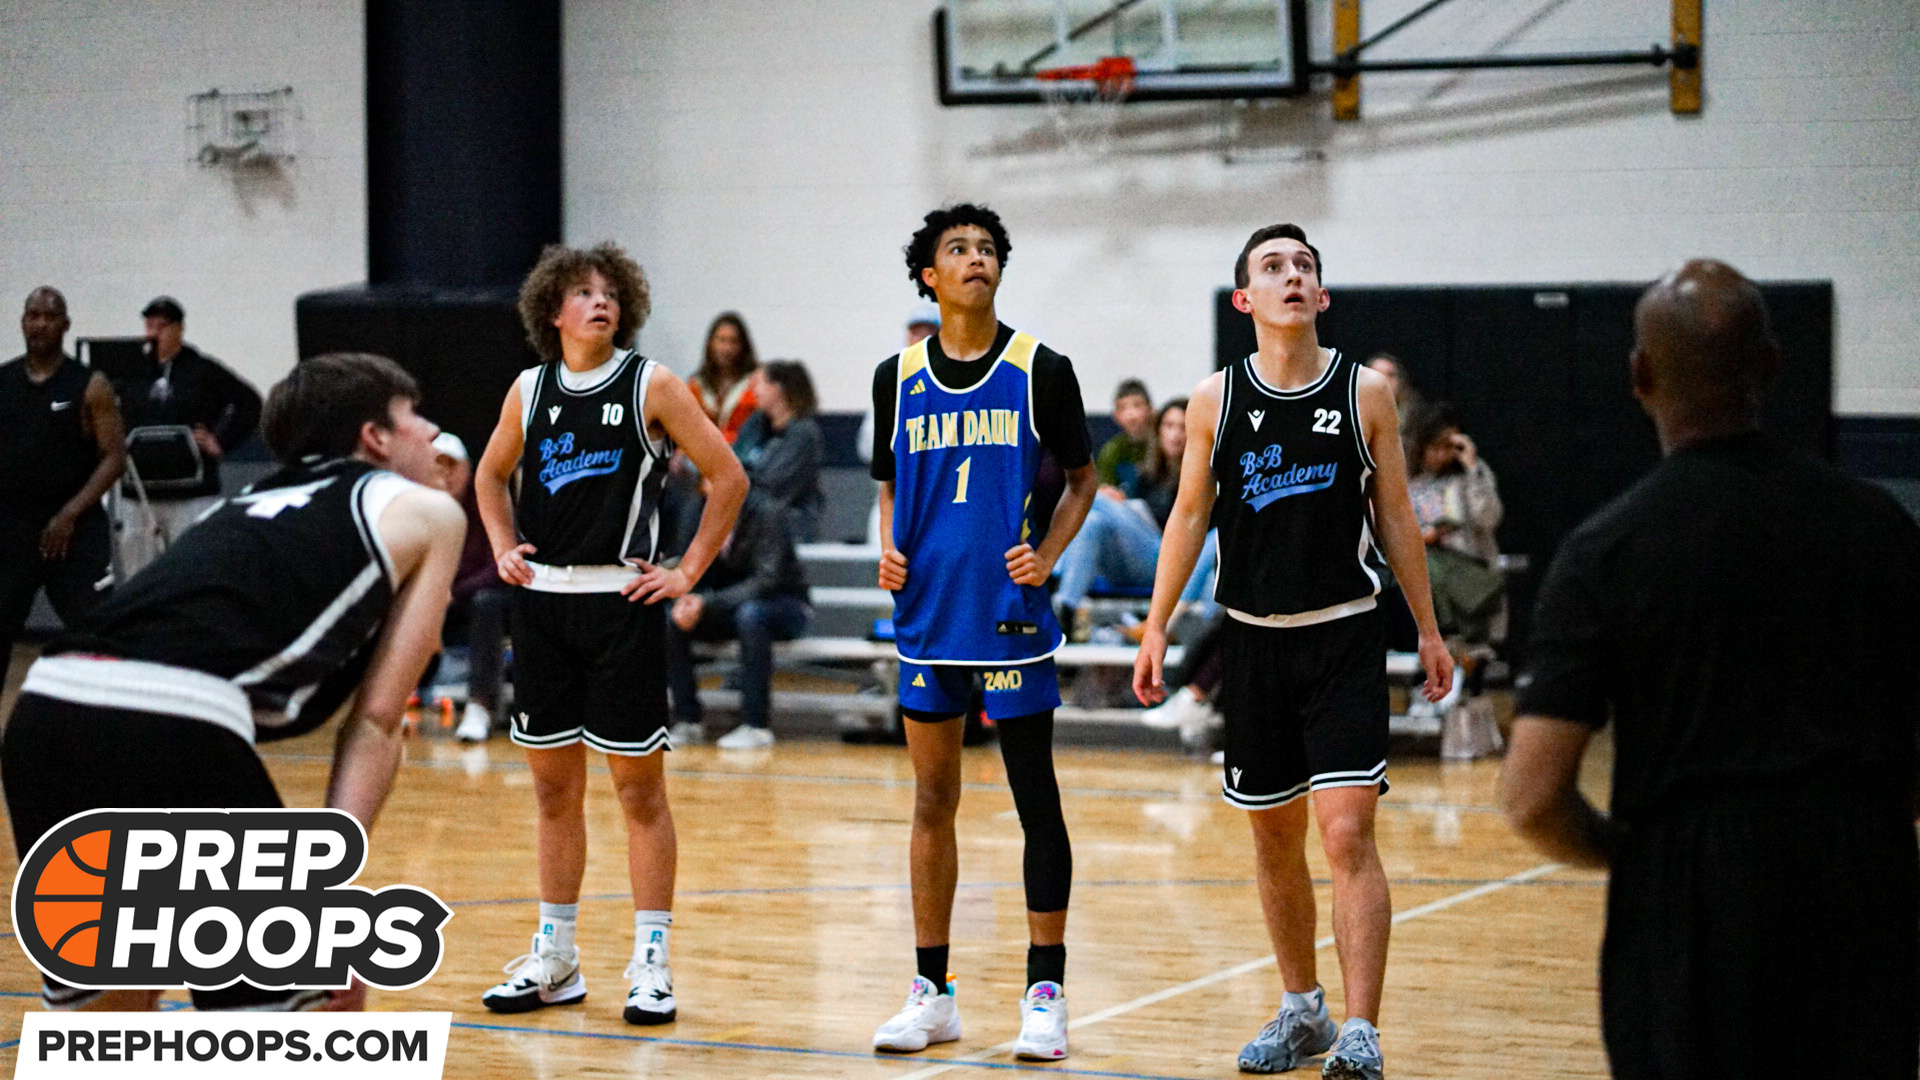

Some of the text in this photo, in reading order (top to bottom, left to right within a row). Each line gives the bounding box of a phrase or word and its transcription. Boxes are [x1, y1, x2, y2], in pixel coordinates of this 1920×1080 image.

[602, 402, 624, 426] 10
[1312, 408, 1342, 435] 22
[906, 415, 959, 454] TEAM
[540, 448, 623, 482] Academy
[1240, 444, 1282, 478] B&B
[952, 456, 971, 503] 1
[1241, 462, 1338, 500] Academy
